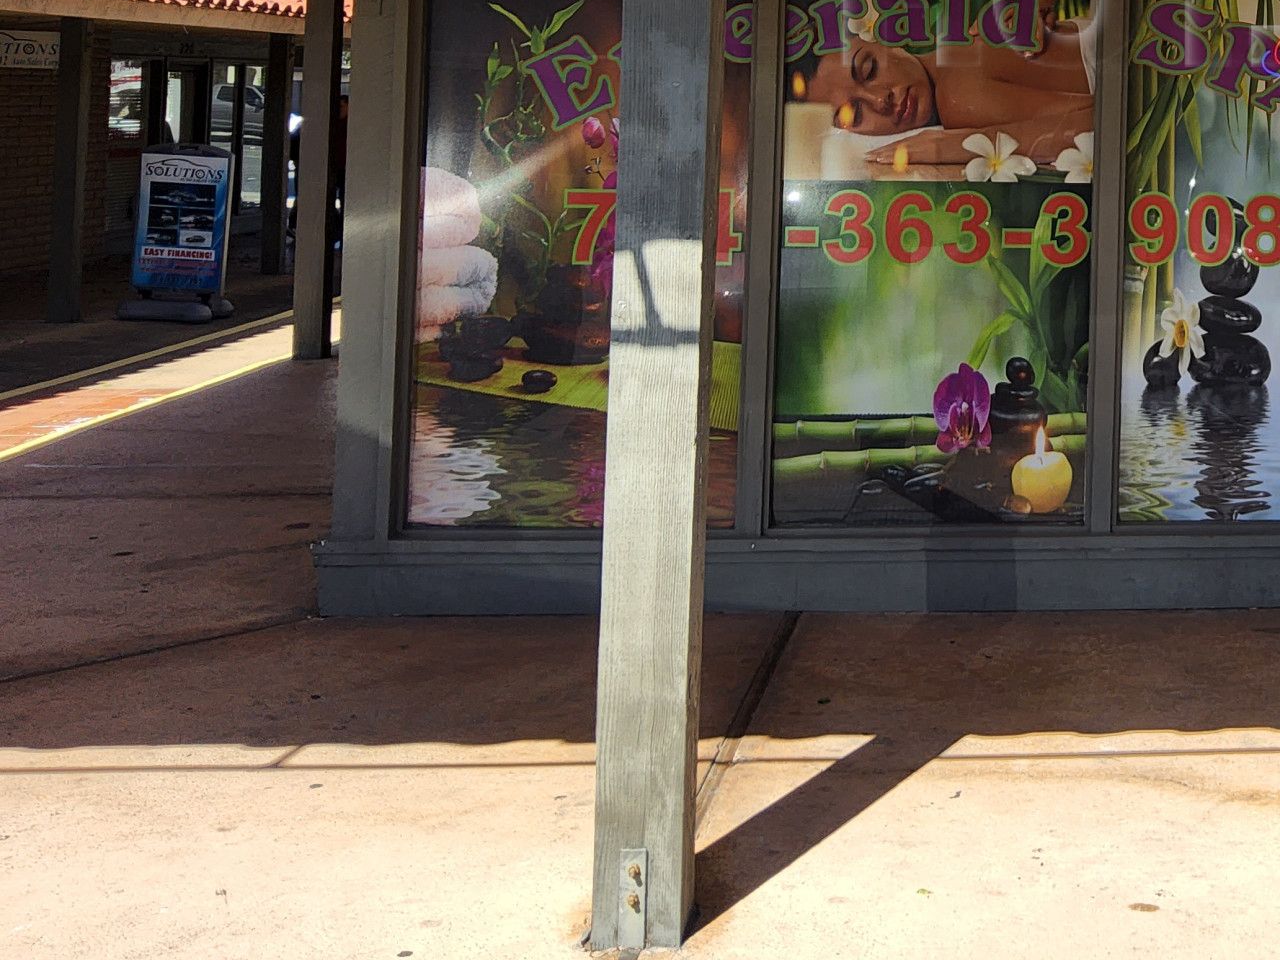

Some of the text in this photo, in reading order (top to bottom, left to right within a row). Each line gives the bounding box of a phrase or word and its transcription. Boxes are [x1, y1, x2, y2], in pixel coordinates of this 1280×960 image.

[145, 165, 224, 180] SOLUTIONS
[144, 247, 213, 259] EASY FINANCING!
